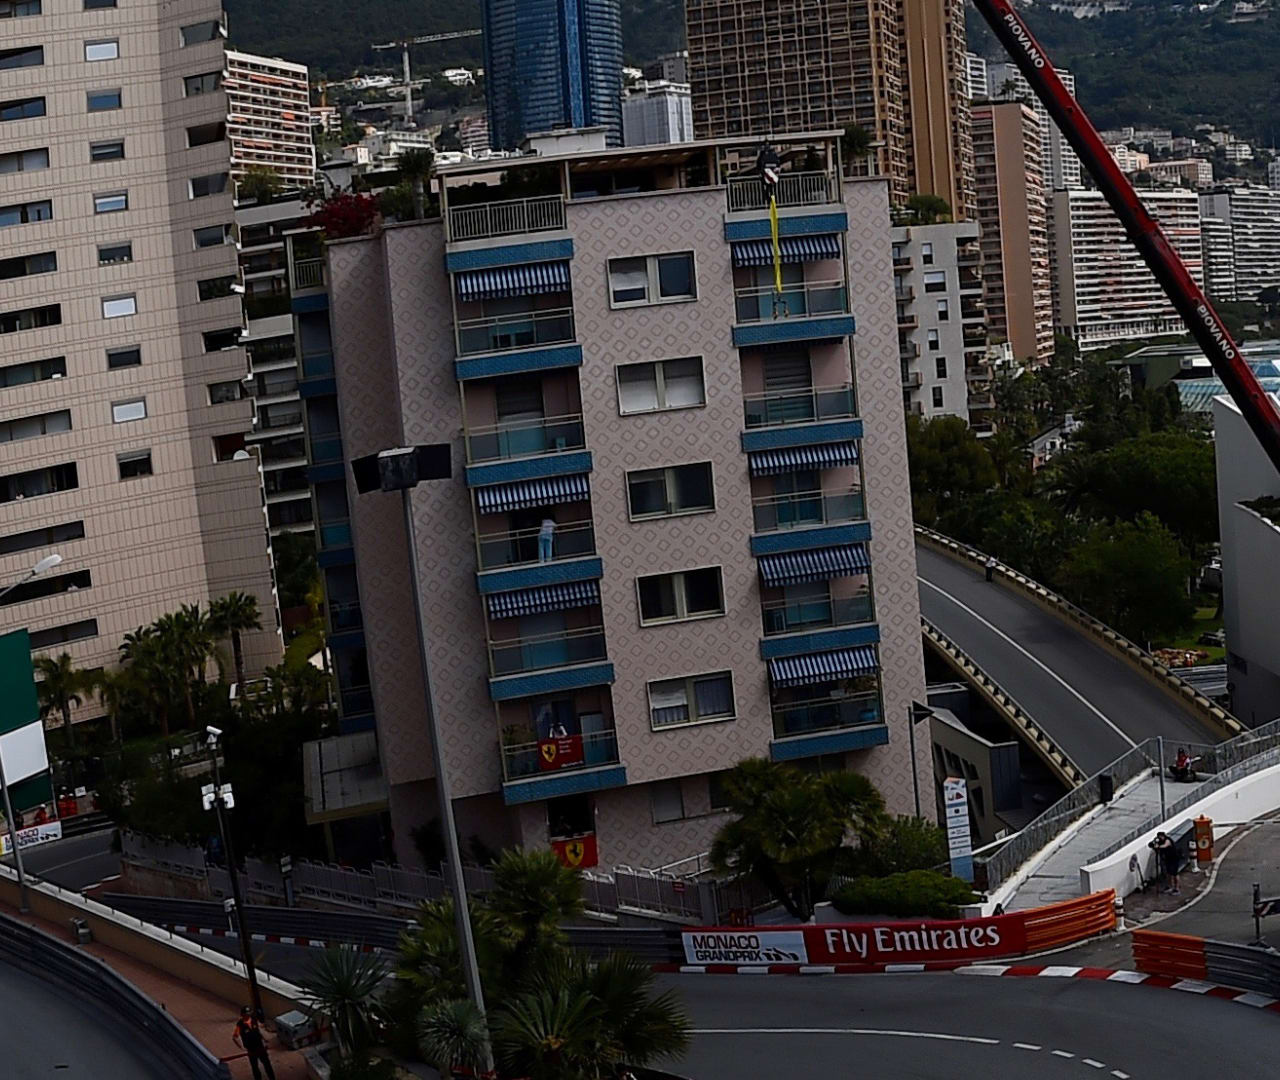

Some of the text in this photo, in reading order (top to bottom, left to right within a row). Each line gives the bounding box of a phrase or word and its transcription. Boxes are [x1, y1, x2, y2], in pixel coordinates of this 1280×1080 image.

[1004, 13, 1045, 68] PIOVANO
[1197, 304, 1235, 360] PIOVANO
[692, 935, 760, 950] MONACO
[825, 924, 1001, 958] Fly Emirates
